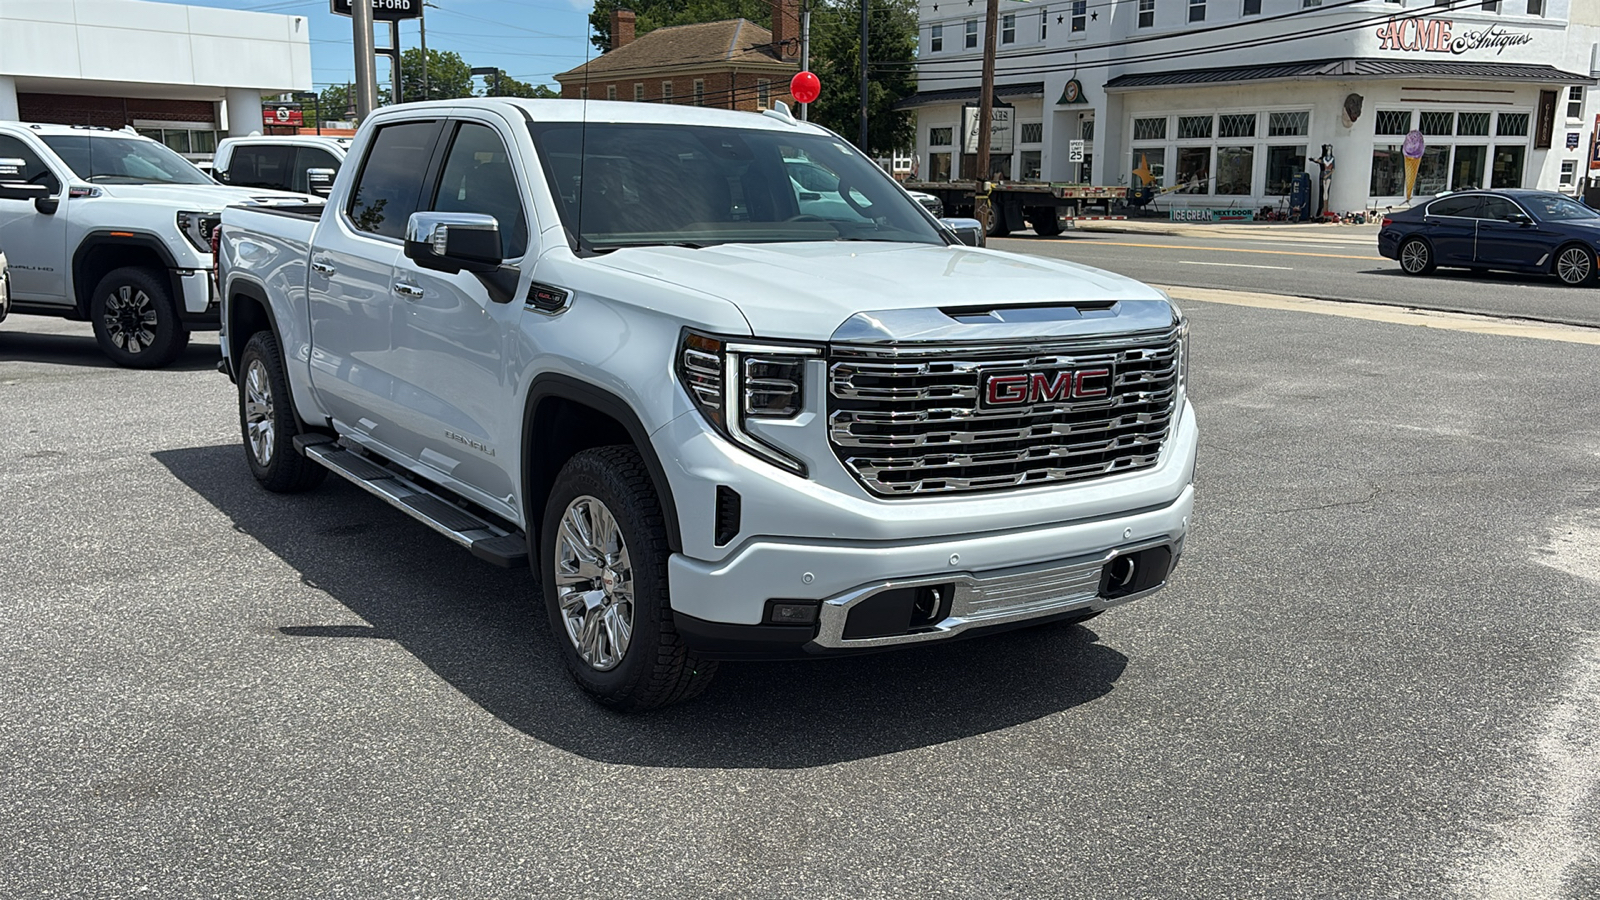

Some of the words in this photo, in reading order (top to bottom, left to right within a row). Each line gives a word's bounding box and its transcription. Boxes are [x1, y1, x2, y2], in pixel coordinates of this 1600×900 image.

[1376, 16, 1453, 53] ACME
[1451, 22, 1533, 55] Antiques
[1070, 151, 1082, 160] 25
[1173, 209, 1186, 220] ICE
[1186, 209, 1213, 221] CREAM
[985, 368, 1109, 405] GMC
[444, 428, 496, 457] DENALI
